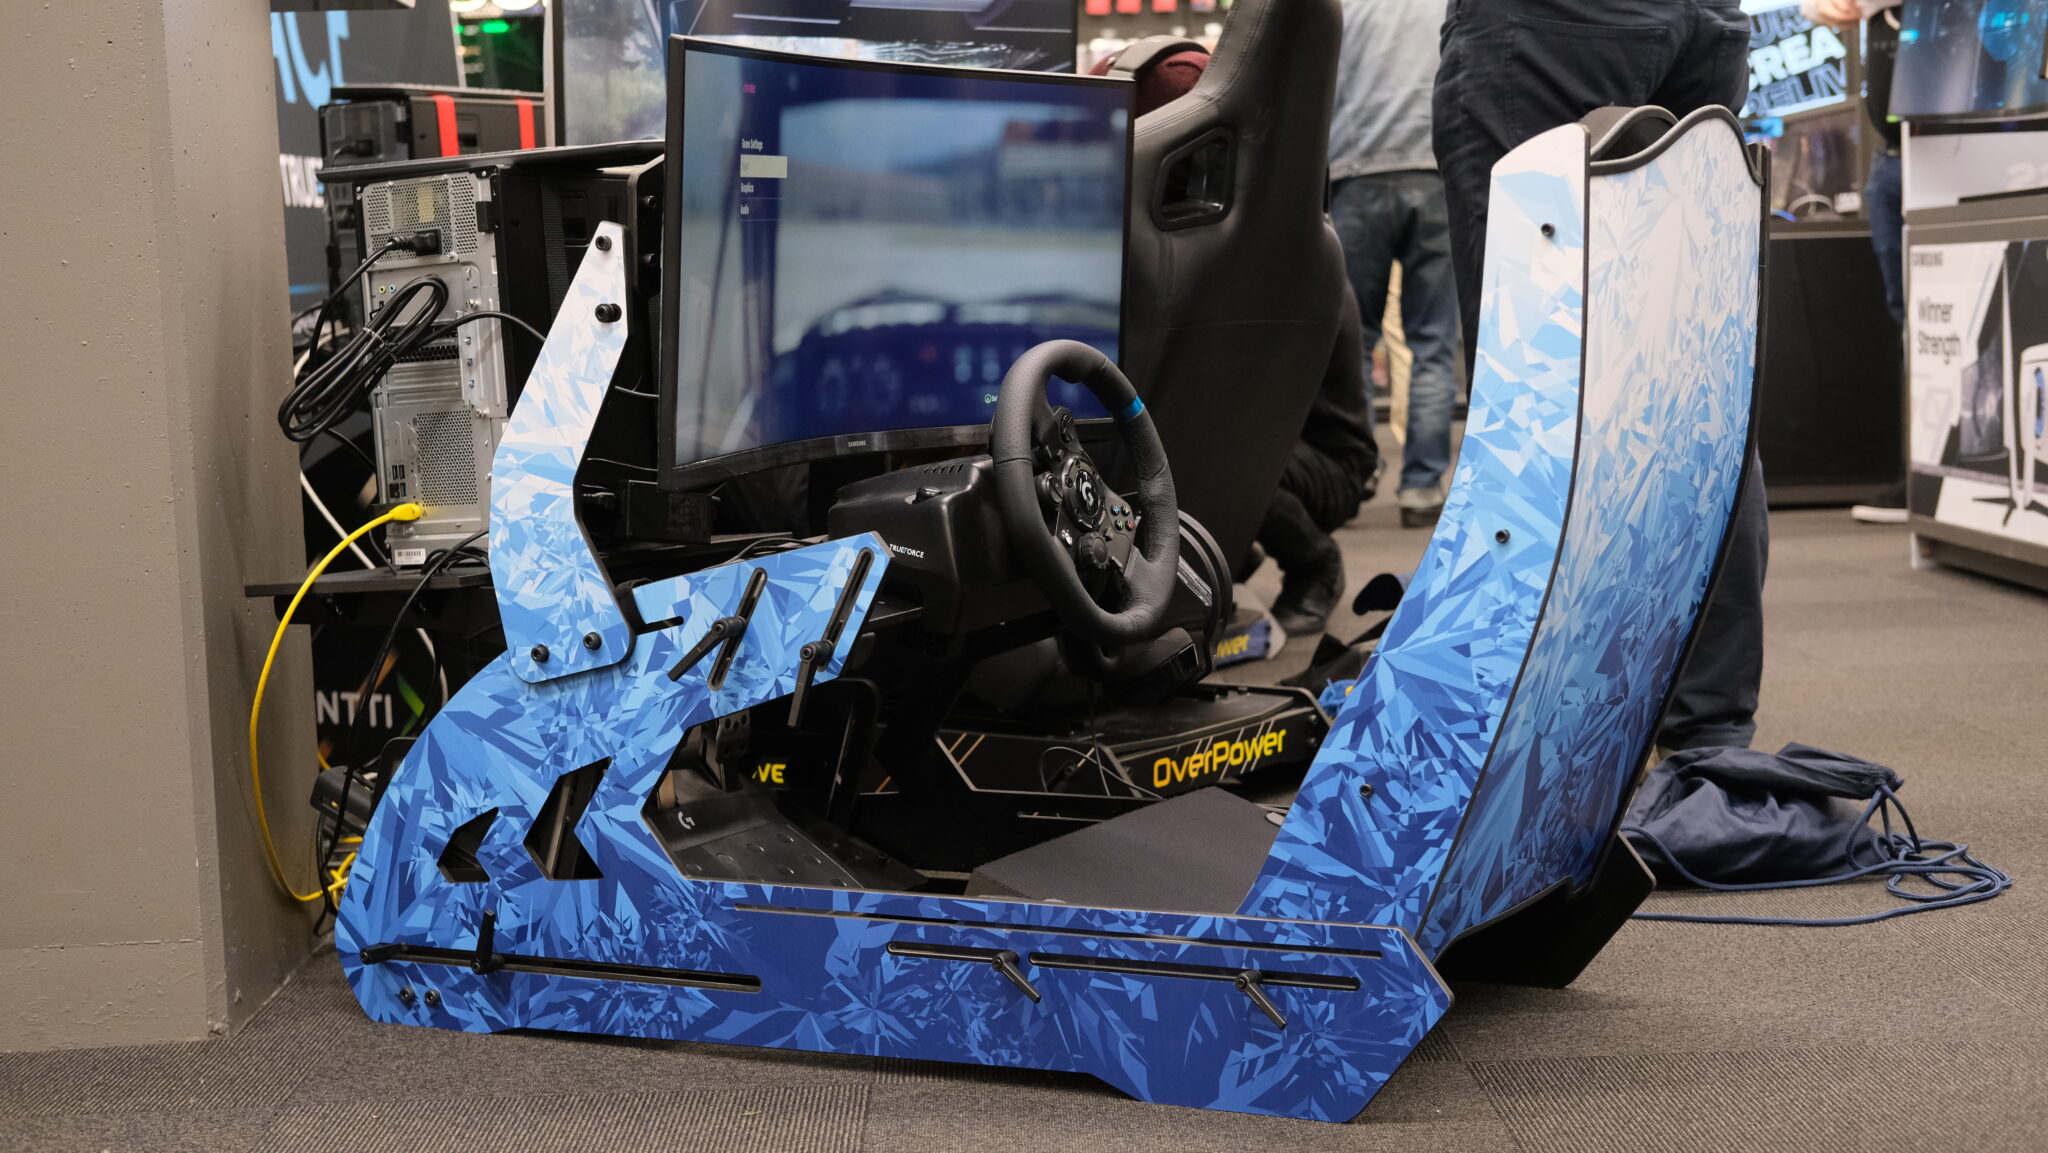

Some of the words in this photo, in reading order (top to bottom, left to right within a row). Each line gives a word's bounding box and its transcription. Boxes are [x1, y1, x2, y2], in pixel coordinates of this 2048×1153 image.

[1918, 297, 1953, 323] Winner
[1918, 331, 1961, 365] Strength
[889, 543, 925, 559] TRUEFORCE
[1153, 729, 1286, 788] OverPower
[752, 763, 786, 784] VE
